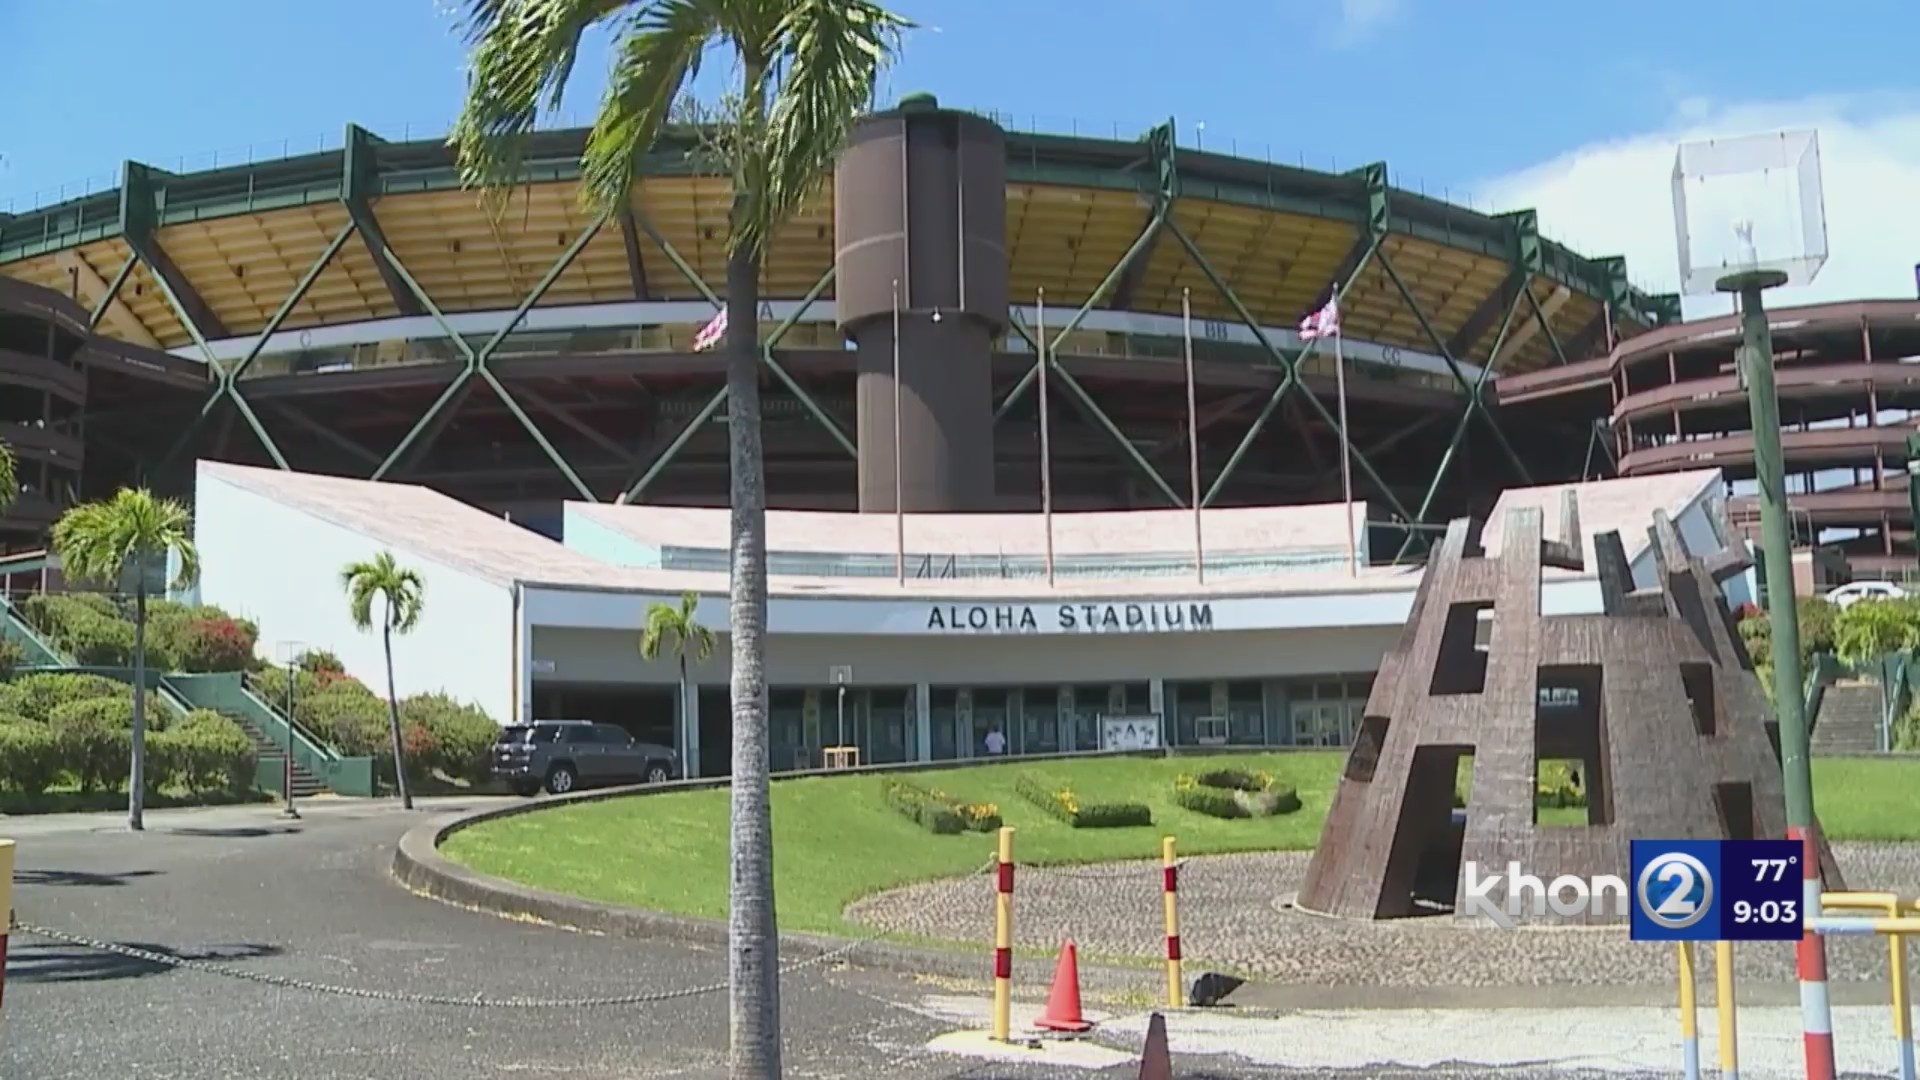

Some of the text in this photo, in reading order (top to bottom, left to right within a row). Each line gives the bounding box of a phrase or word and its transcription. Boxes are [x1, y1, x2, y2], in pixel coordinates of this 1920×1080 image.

[1204, 319, 1229, 341] BB
[927, 603, 1213, 630] ALOHA STADIUM
